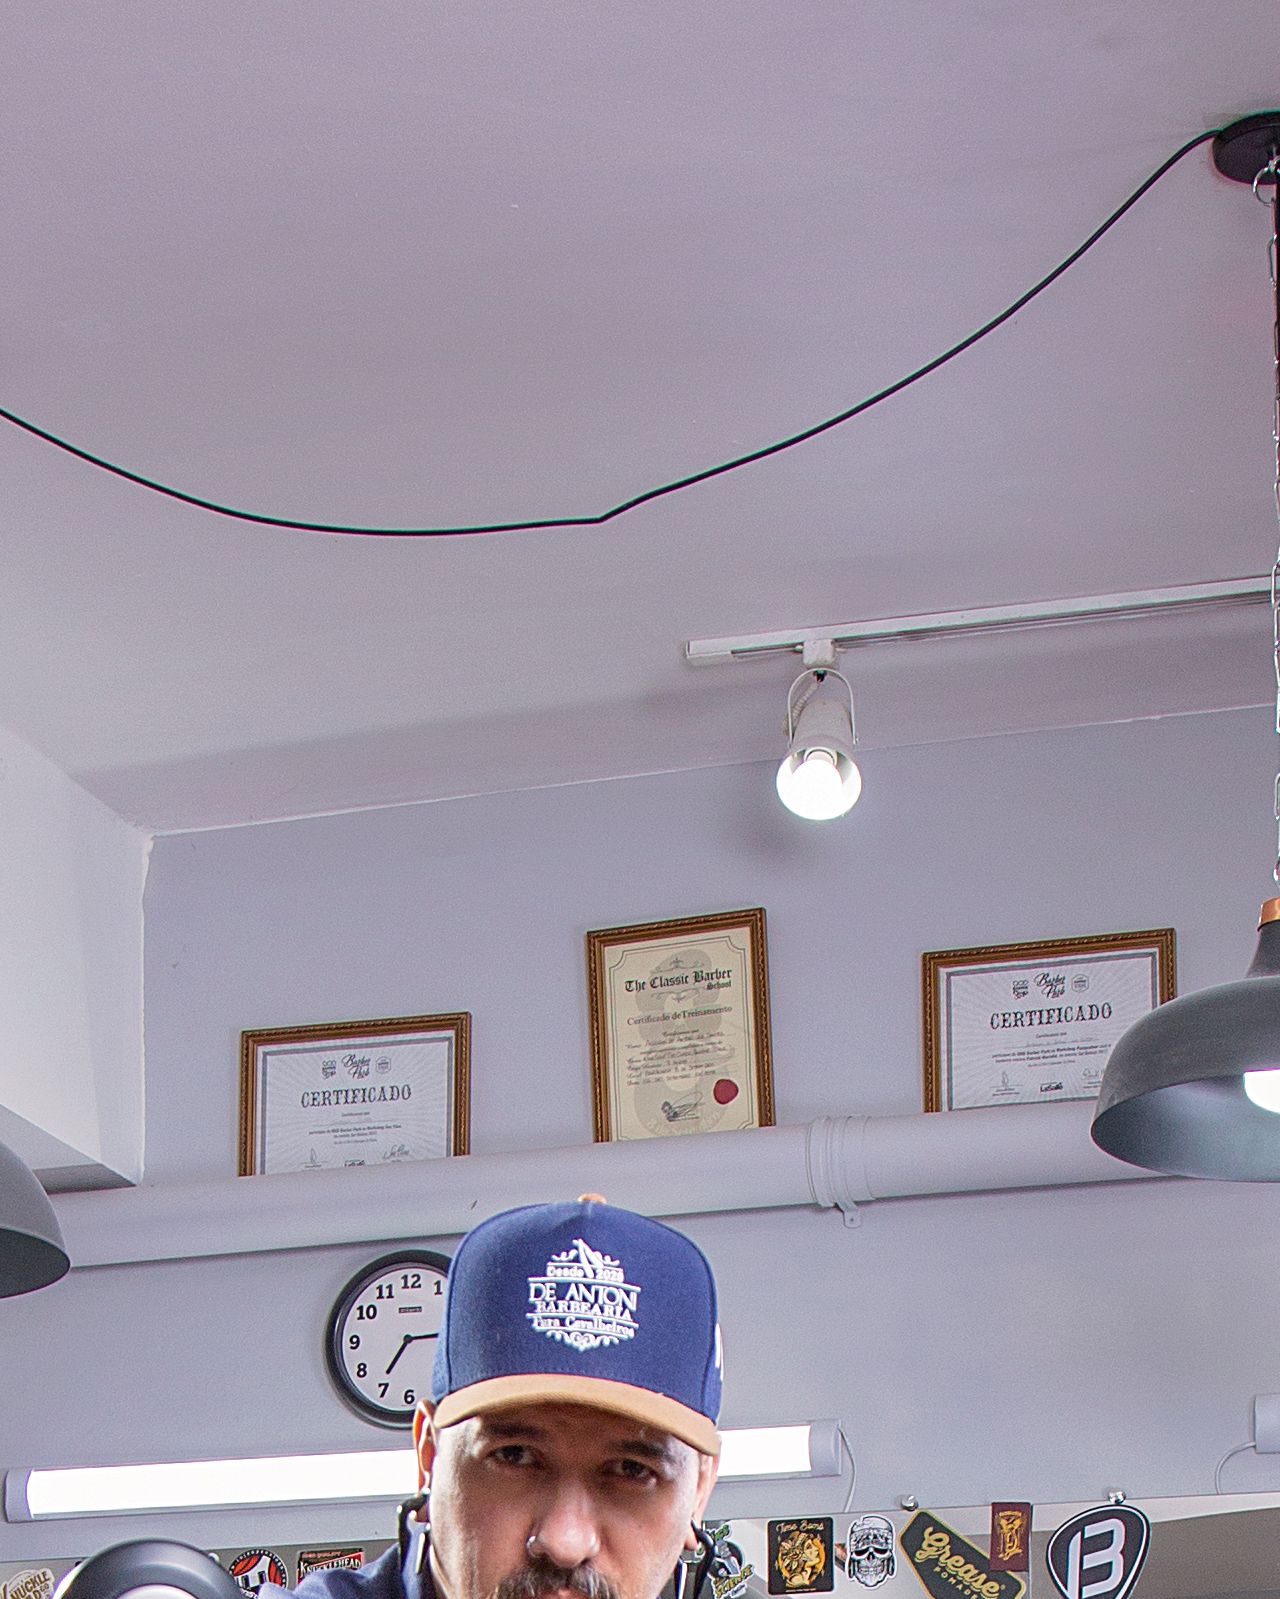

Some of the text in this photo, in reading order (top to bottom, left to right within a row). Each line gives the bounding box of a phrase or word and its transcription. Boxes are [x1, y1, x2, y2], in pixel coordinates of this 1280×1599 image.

[624, 969, 733, 993] The Classic Barber
[706, 981, 732, 991] School
[627, 1013, 670, 1026] Certificado
[990, 1002, 1113, 1030] CERTIFICADO
[301, 1084, 412, 1108] CERTIFICADO
[547, 1266, 574, 1278] Desde
[401, 1274, 422, 1289] 12
[434, 1280, 443, 1295] 1
[376, 1284, 394, 1299] 11
[529, 1283, 557, 1301] DE
[356, 1304, 377, 1320] 10
[535, 1301, 633, 1321] BARBEARIA
[533, 1315, 634, 1337] Para Cavalheiros
[349, 1335, 360, 1350] 9
[356, 1363, 367, 1378] 8
[378, 1383, 389, 1398] 7
[403, 1390, 415, 1404] 6
[914, 1525, 1001, 1599] Grease
